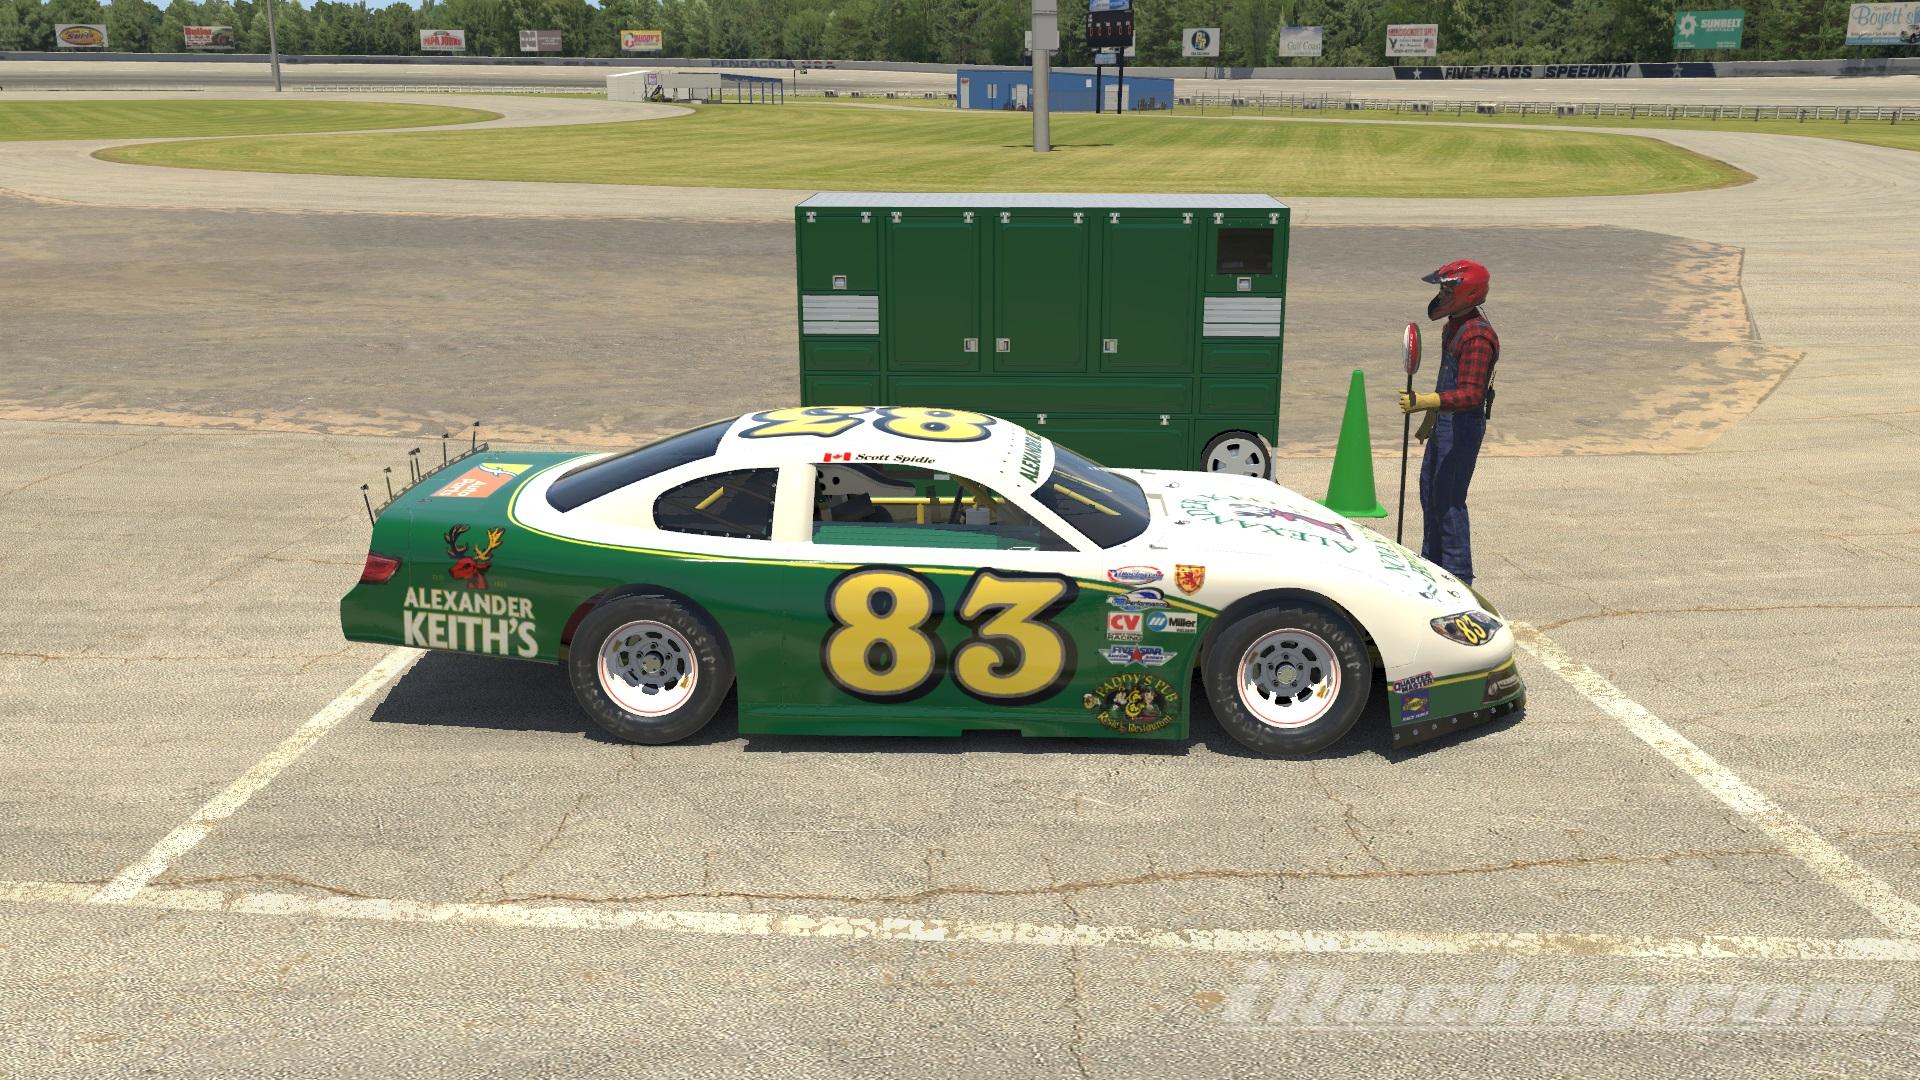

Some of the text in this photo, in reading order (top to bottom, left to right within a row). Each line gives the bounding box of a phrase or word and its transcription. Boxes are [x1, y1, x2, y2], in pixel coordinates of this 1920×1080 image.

[1700, 18, 1742, 29] SUNBELT
[1852, 4, 1913, 30] Boyett's
[711, 60, 796, 69] PENSACOLA
[1445, 65, 1631, 79] FIVE FLAGS SPEEDWAY
[855, 453, 936, 465] Scott Spidle
[404, 587, 536, 620] ALEXANDER
[1110, 614, 1140, 631] CV
[1169, 617, 1196, 628] Miller
[1454, 615, 1487, 645] 83
[403, 610, 539, 658] KEITH'S
[819, 565, 1081, 706] 83
[1140, 647, 1162, 655] STAR
[1154, 679, 1178, 702] PUB
